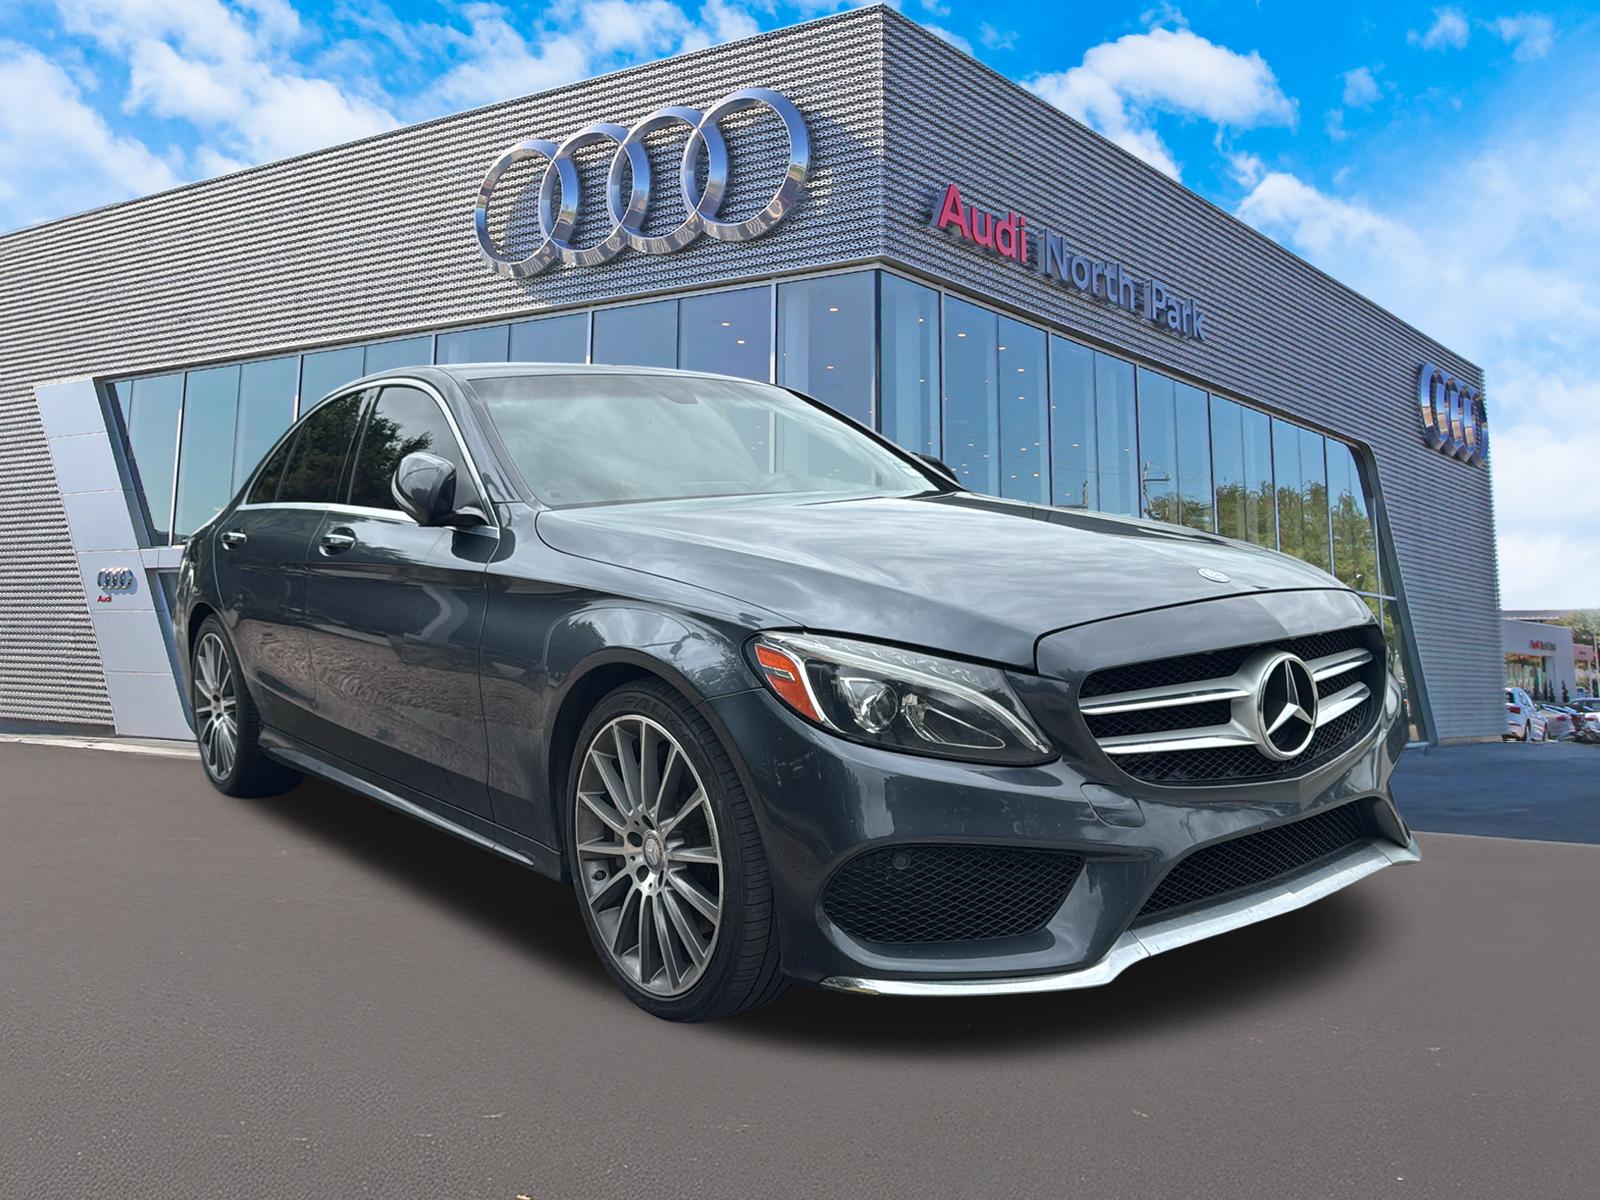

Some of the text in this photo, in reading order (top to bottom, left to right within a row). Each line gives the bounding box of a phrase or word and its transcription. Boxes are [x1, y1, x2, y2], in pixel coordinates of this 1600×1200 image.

[935, 183, 1207, 340] Audi North Park
